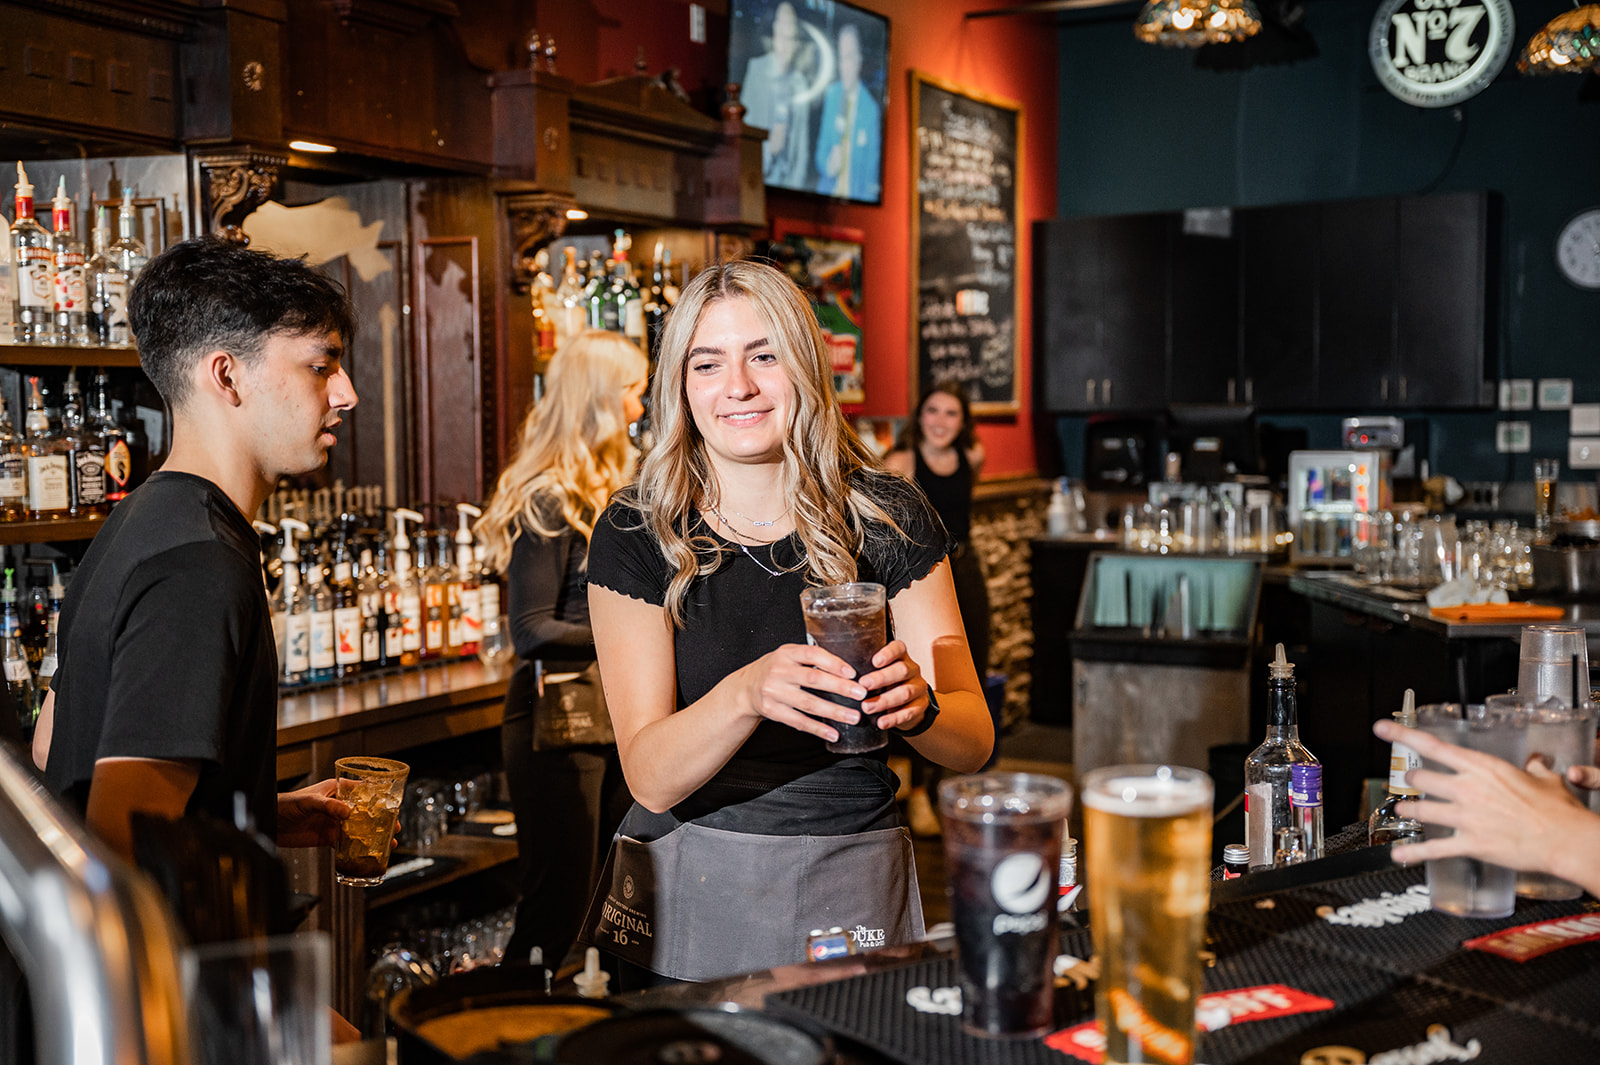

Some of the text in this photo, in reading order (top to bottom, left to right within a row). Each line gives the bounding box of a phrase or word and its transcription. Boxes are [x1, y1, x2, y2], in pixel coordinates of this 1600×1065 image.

[602, 901, 652, 937] ORIGINAL
[613, 929, 628, 945] 16
[848, 929, 885, 941] DUKE
